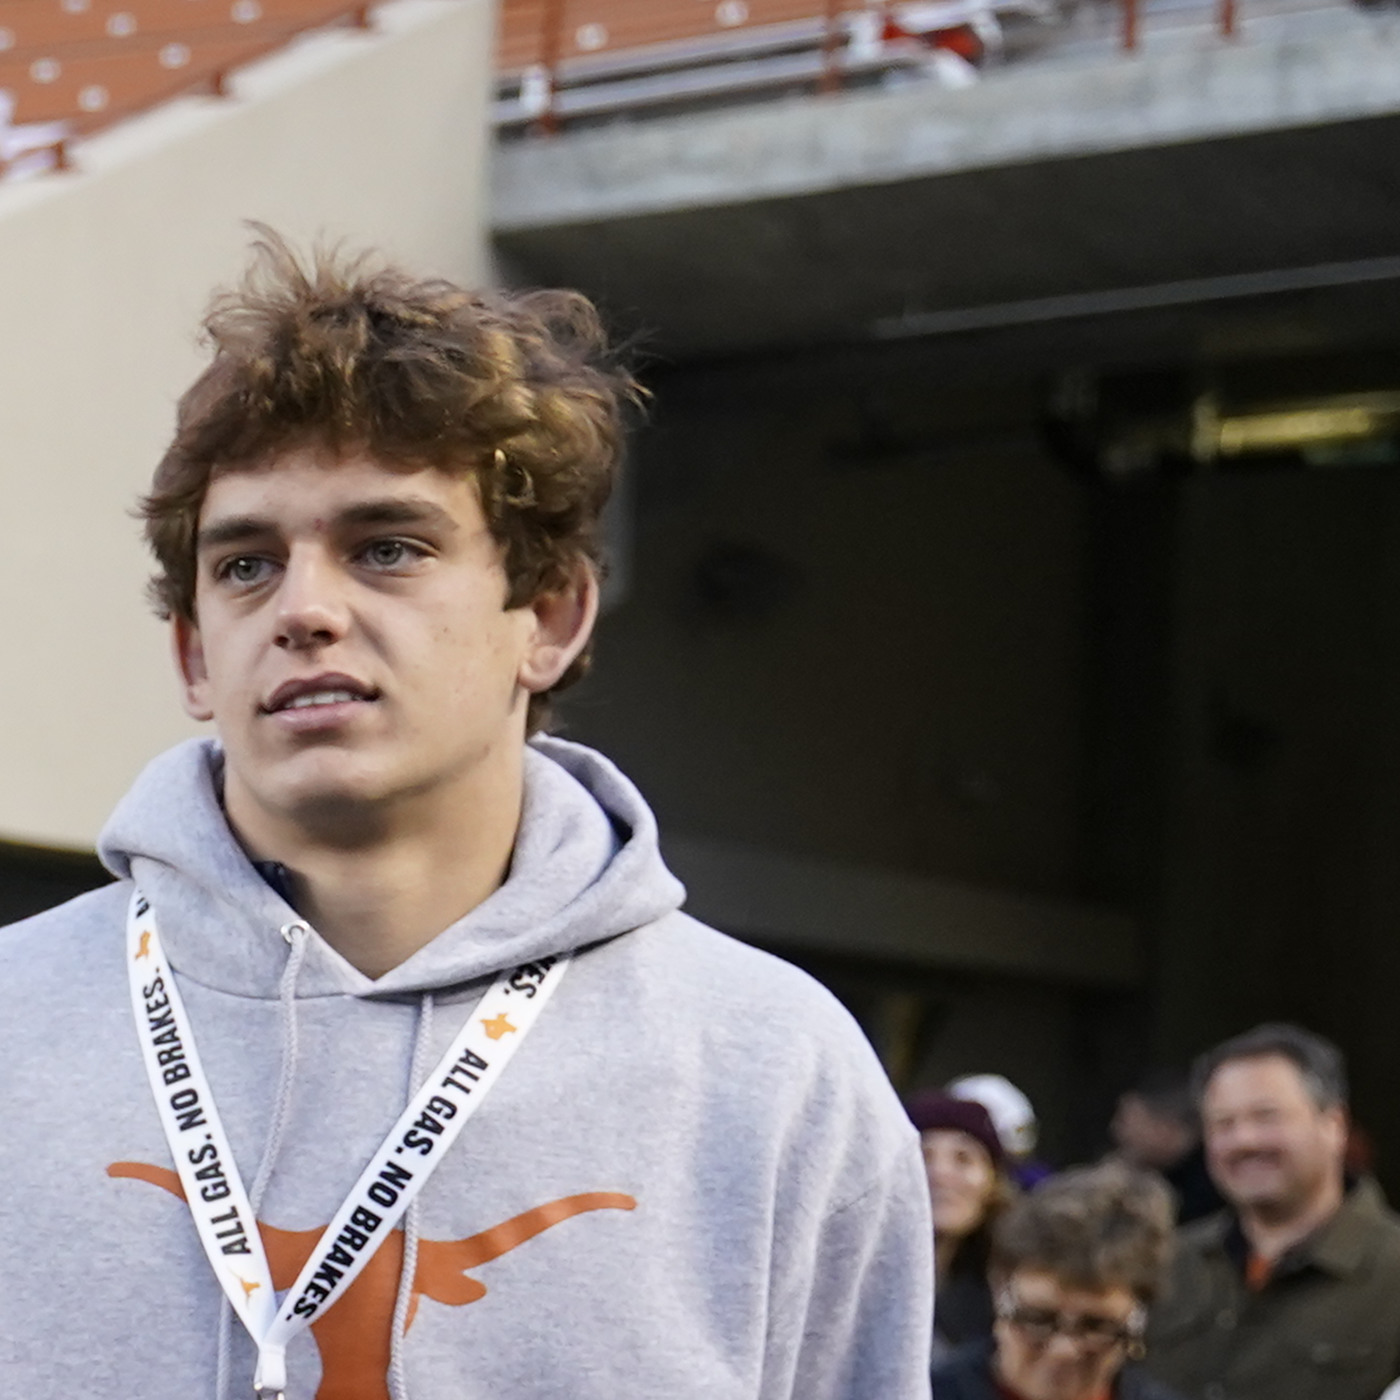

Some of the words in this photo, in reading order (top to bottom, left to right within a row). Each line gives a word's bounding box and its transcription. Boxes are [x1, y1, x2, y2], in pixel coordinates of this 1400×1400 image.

[142, 967, 191, 1086] BRAKES.
[441, 1047, 489, 1095] ALL
[170, 1087, 207, 1131] NO
[395, 1095, 458, 1156] GAS.
[188, 1133, 231, 1202] GAS.
[367, 1160, 413, 1208] NO
[210, 1204, 252, 1255] ALL
[286, 1205, 383, 1321] BRAKES.
